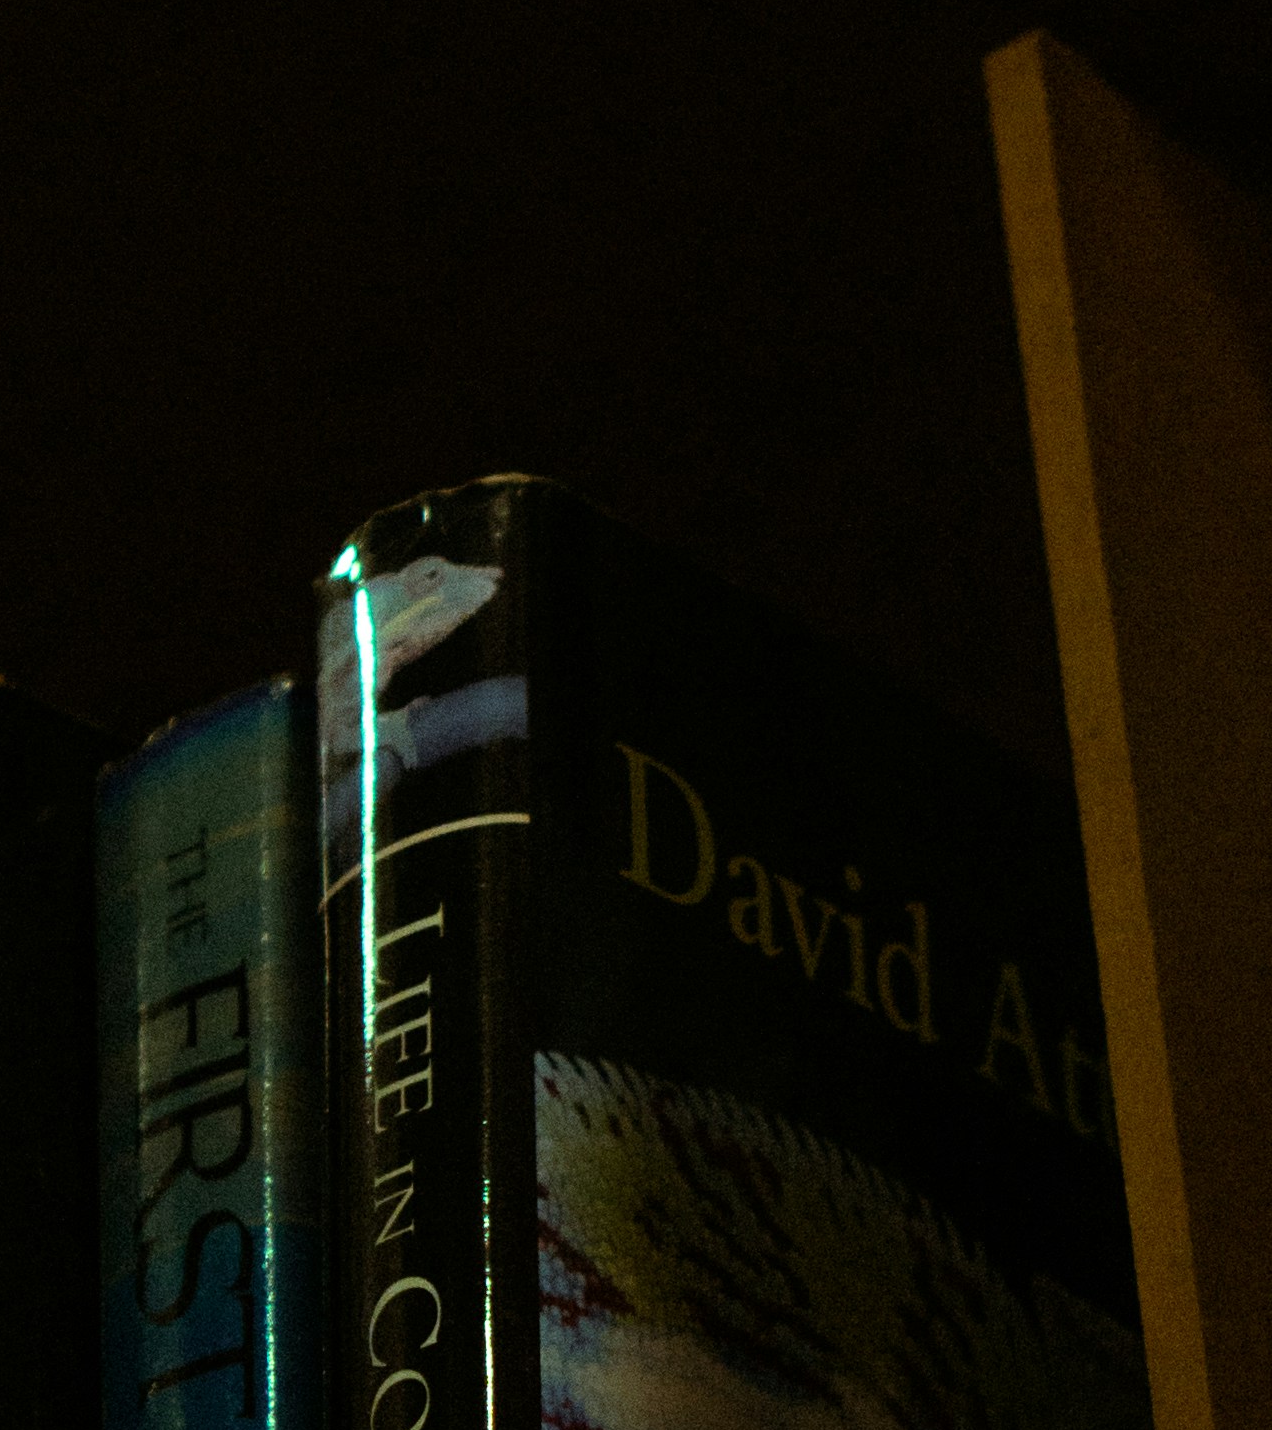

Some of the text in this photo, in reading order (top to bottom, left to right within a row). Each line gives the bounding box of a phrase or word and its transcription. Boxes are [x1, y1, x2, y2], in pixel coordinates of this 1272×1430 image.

[163, 825, 209, 946] THE
[617, 742, 935, 1046] David
[135, 960, 255, 1420] FIRST
